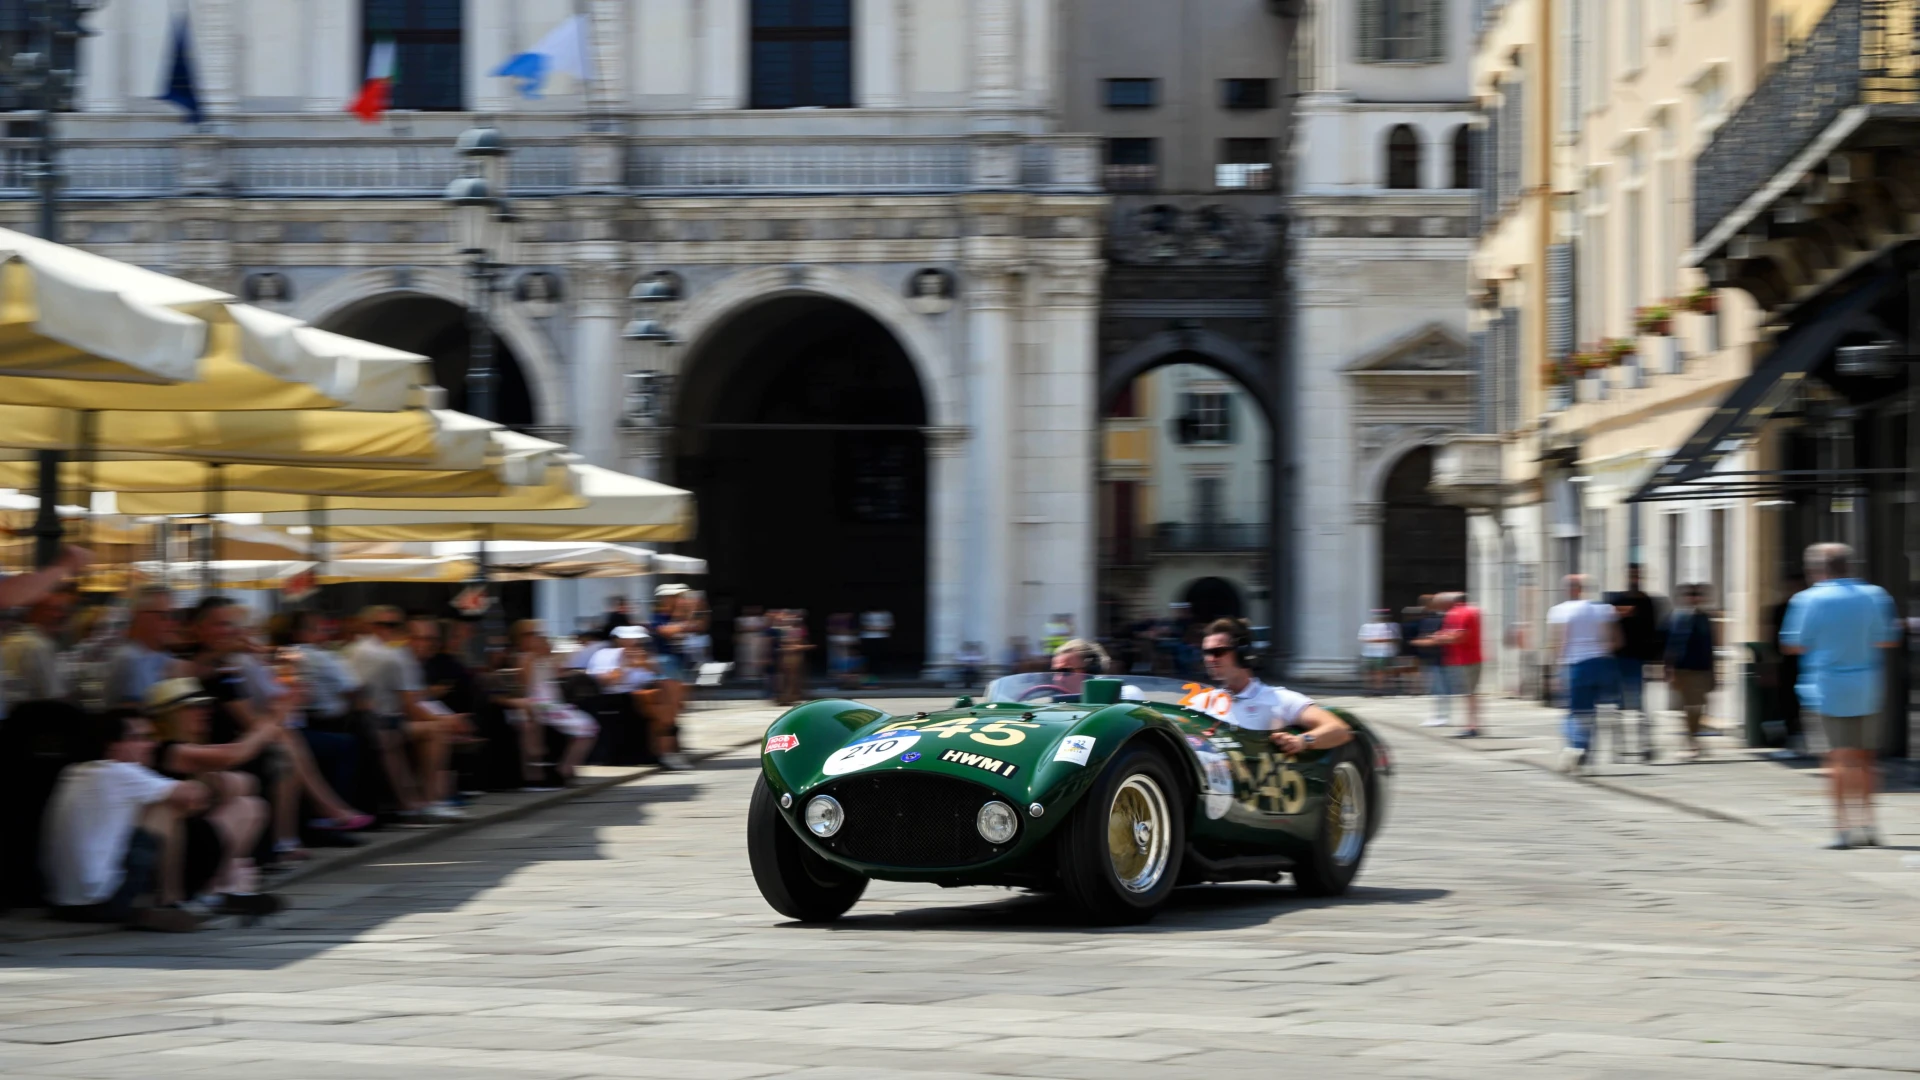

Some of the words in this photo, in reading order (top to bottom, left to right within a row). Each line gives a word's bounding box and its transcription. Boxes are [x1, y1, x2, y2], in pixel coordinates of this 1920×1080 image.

[1177, 682, 1232, 715] 210
[840, 740, 899, 761] 210
[942, 749, 1004, 773] HWM
